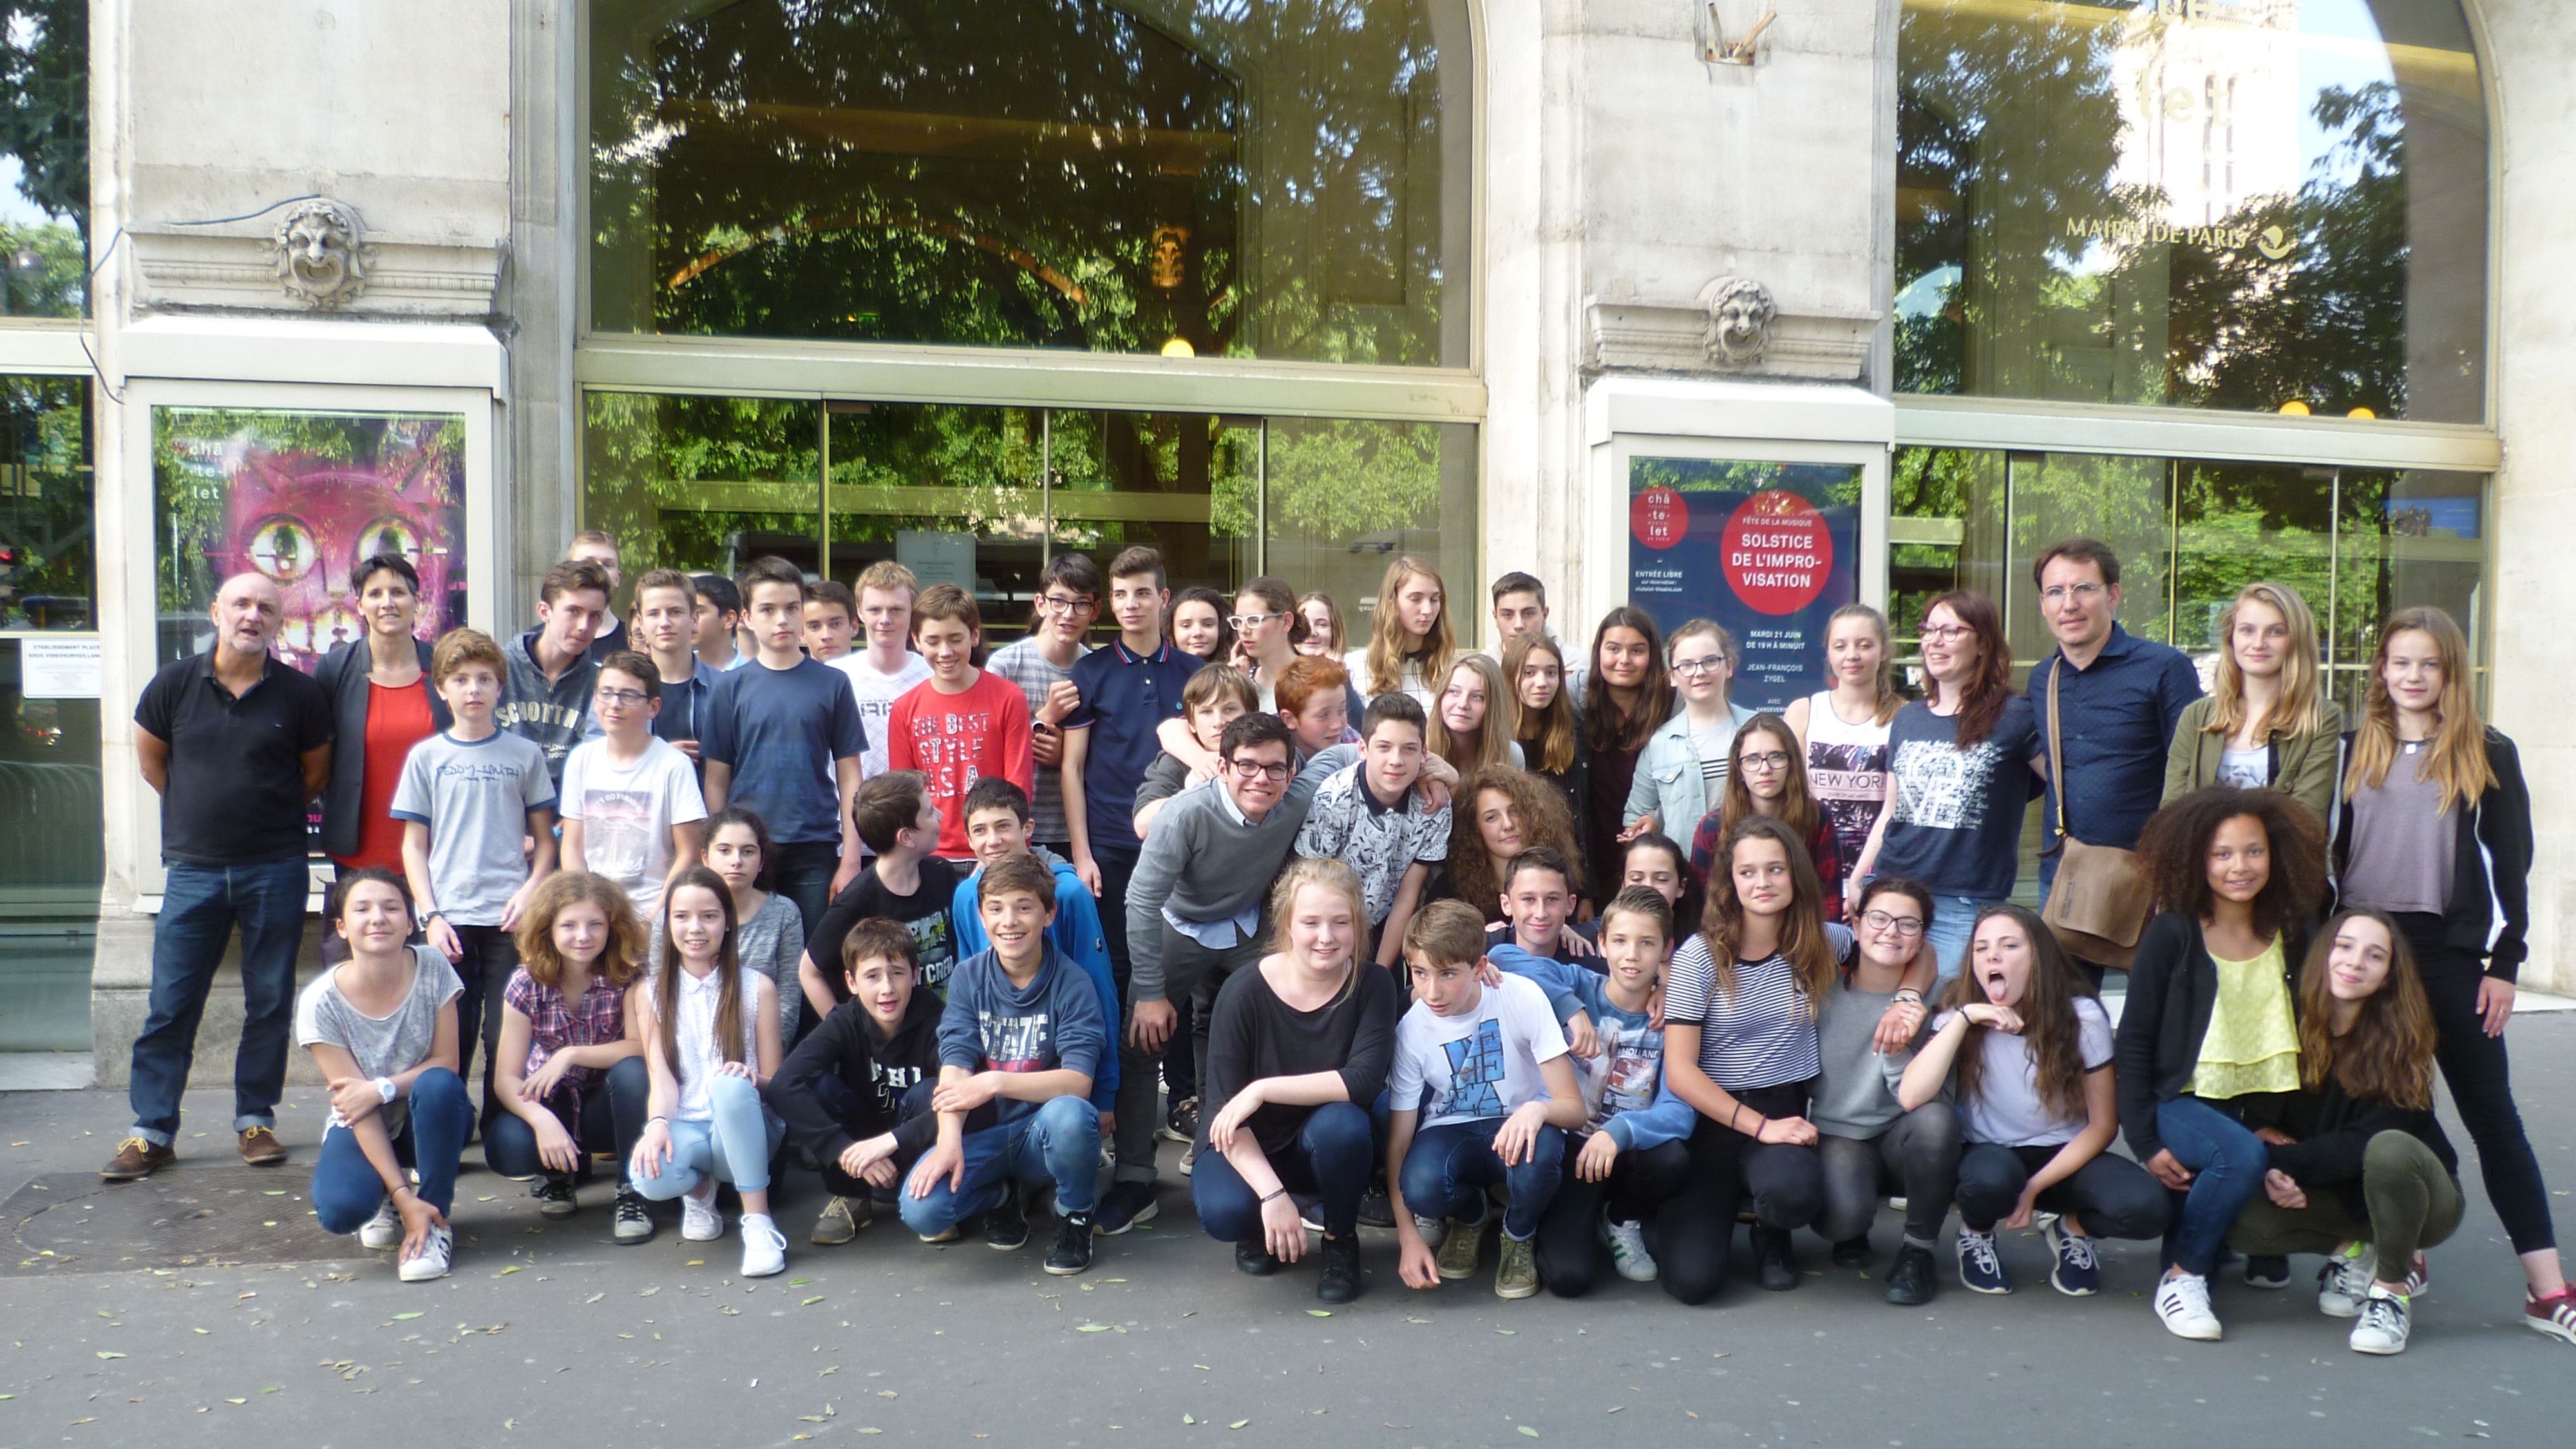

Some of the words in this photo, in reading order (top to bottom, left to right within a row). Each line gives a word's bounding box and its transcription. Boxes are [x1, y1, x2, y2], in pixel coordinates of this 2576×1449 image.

[2152, 223, 2179, 243] DE
[2188, 227, 2246, 249] PARIS
[194, 486, 219, 499] let
[1648, 493, 1670, 504] châ
[1743, 516, 1759, 526] FÊTE
[1781, 518, 1812, 527] MUSIQUE
[1650, 526, 1668, 536] let
[1742, 534, 1813, 549] SOLSTICE
[1732, 553, 1751, 566] DE
[1743, 573, 1810, 588] VISATION
[1747, 664, 1803, 673] JEAN-FRANÇOIS
[495, 701, 564, 727] SCHOTT
[913, 715, 942, 737] THE
[946, 712, 989, 735] BEST
[919, 737, 984, 764] STYLE
[1810, 773, 1842, 786] NEW
